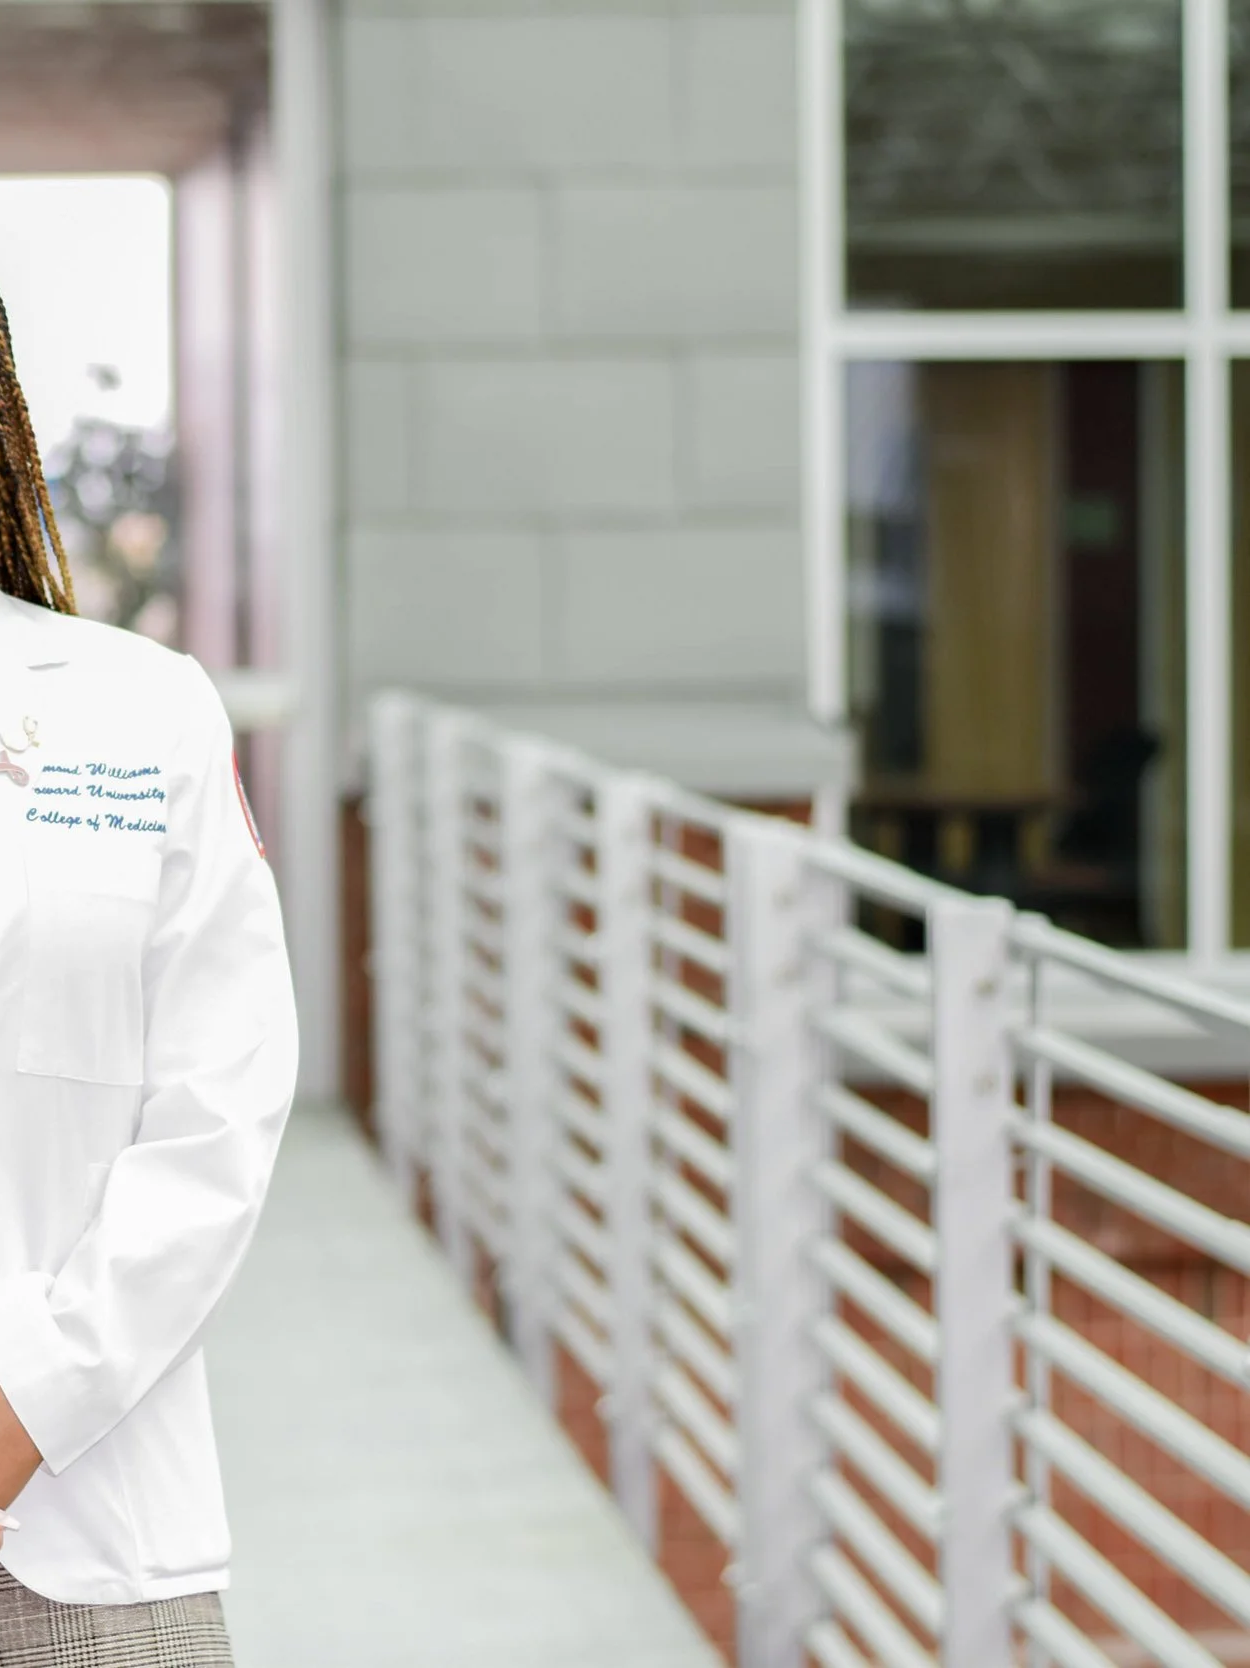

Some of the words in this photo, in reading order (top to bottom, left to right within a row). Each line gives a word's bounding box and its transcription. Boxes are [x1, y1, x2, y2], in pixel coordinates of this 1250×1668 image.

[85, 762, 161, 780] Williams
[33, 785, 82, 797] oward
[86, 784, 166, 804] University
[25, 807, 82, 829] College
[86, 813, 101, 832] of
